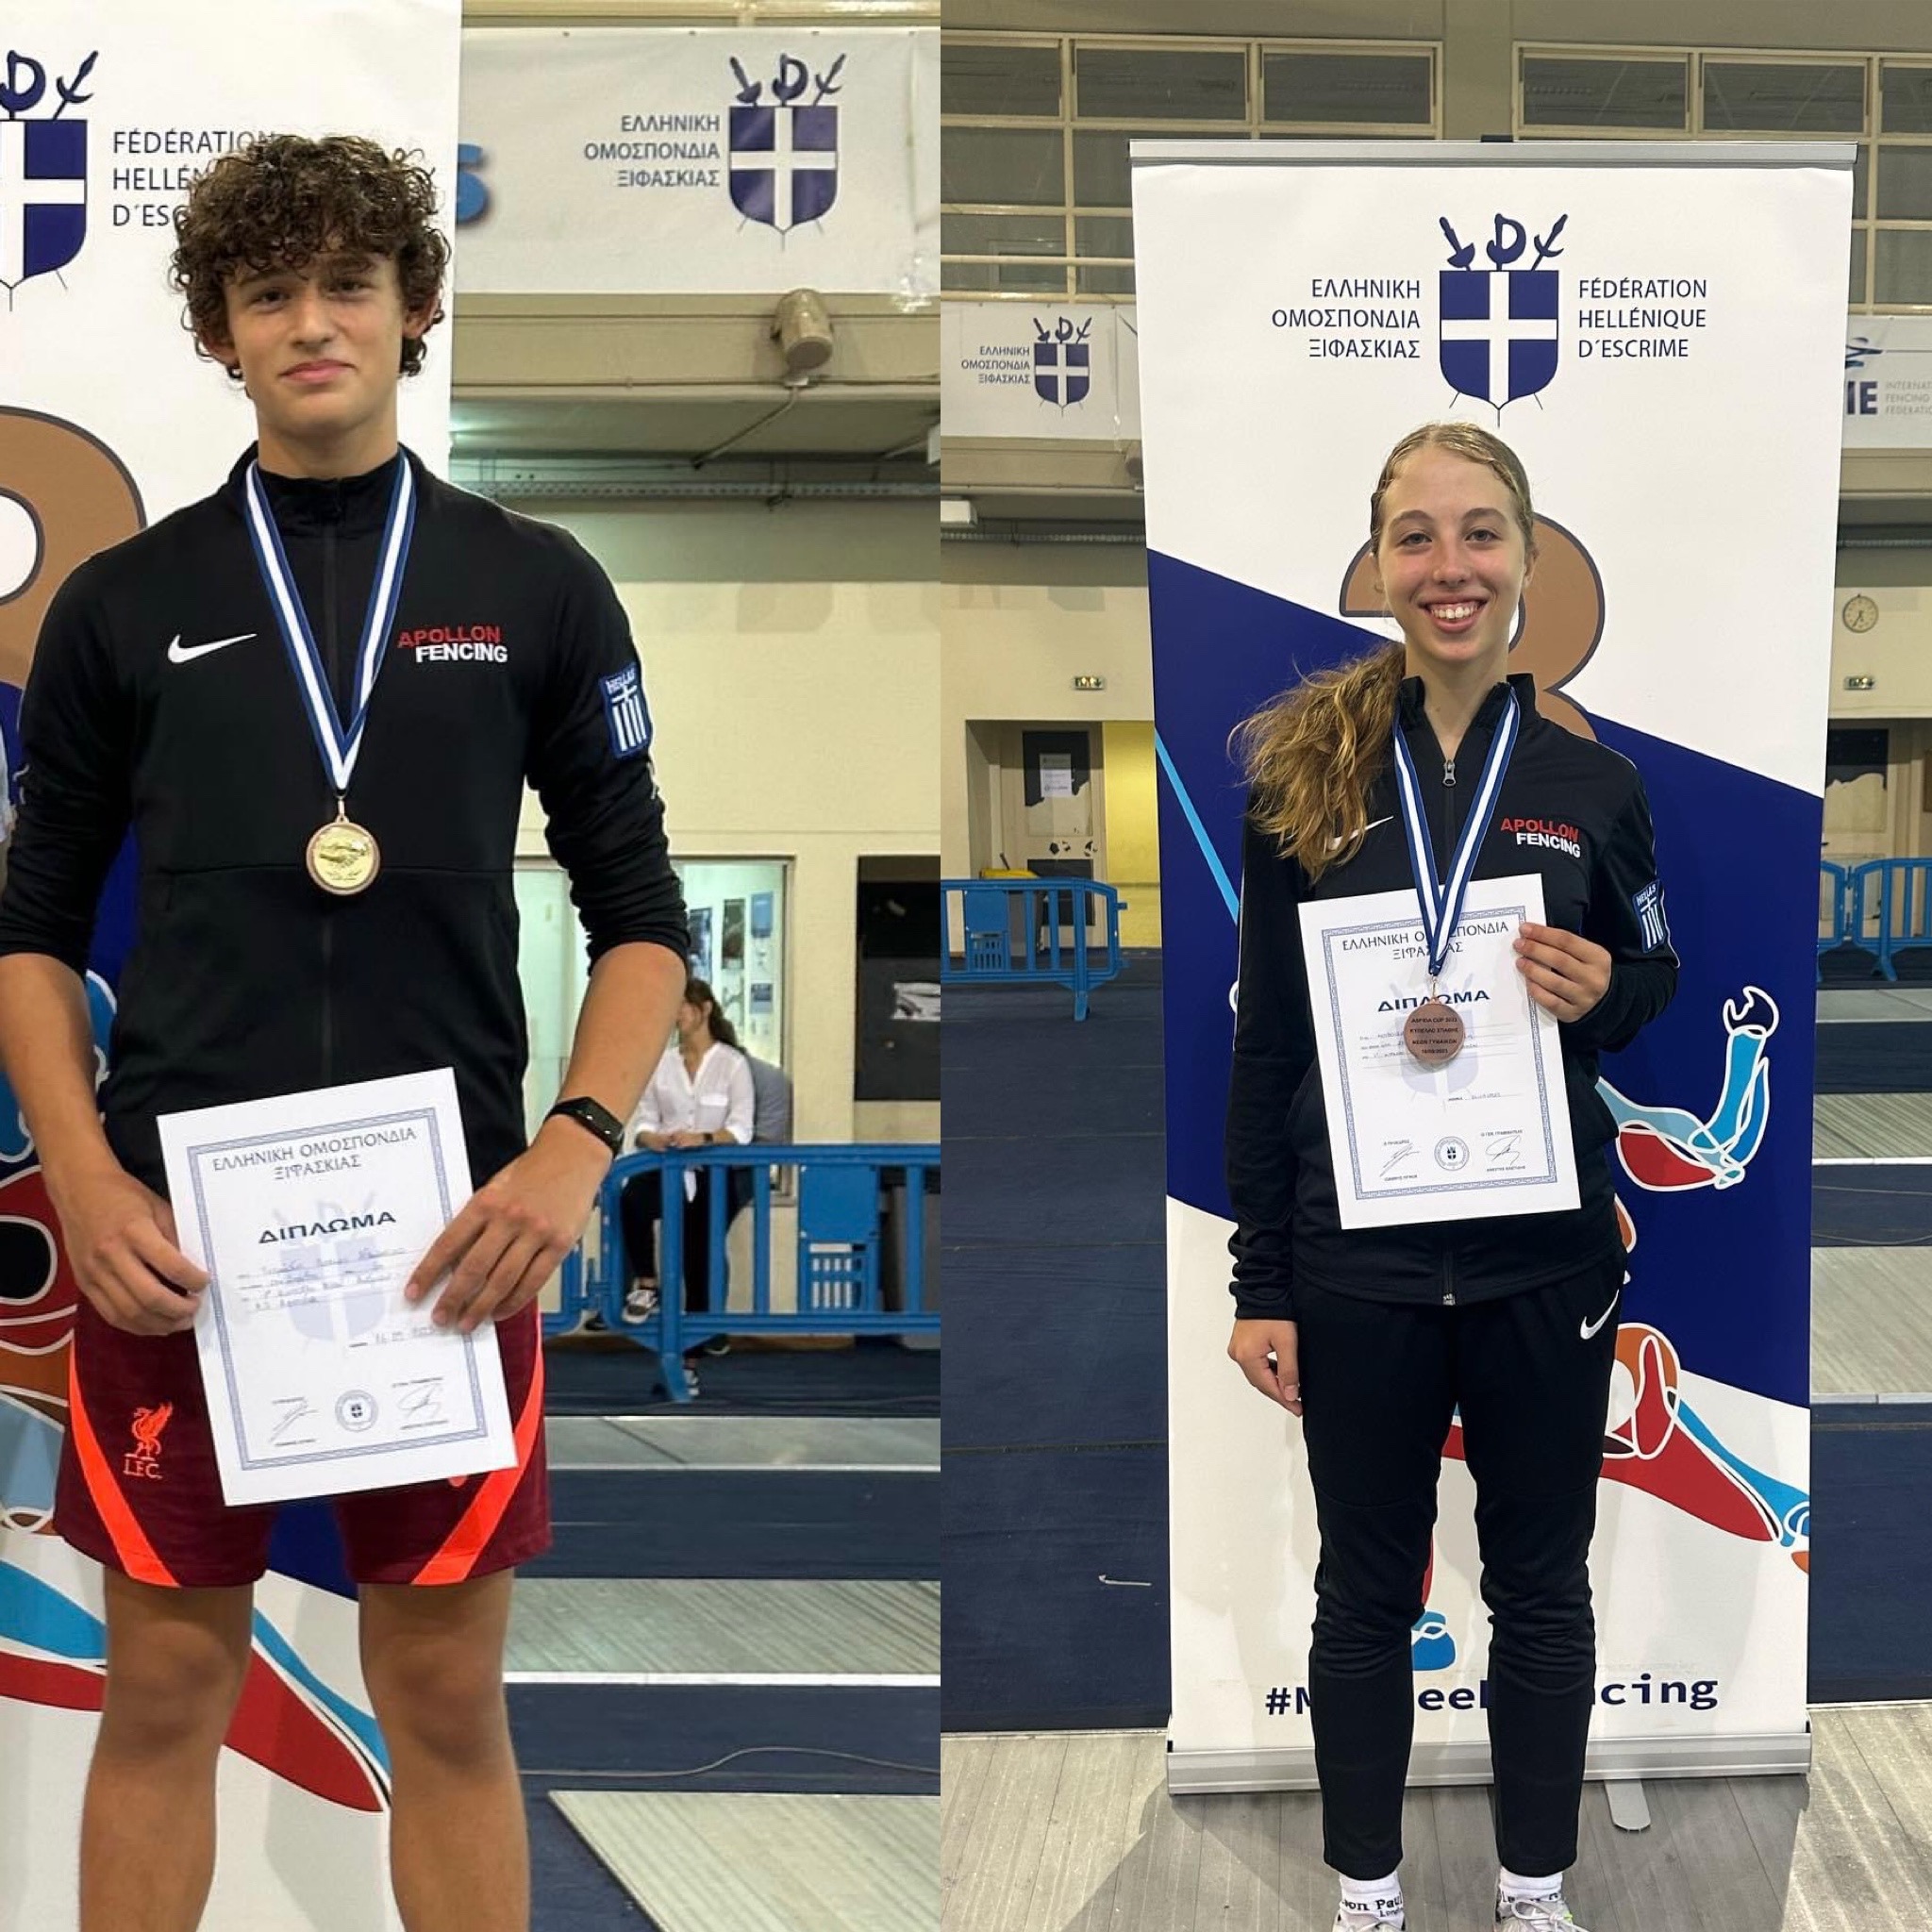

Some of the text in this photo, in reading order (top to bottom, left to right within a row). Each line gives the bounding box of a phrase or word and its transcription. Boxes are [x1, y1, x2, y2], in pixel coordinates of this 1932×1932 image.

[620, 114, 720, 131] ΕΛΛΗΝΙΚΗ
[584, 142, 720, 159] ΟΜΟΣΠΟΝΔΙΑ
[617, 170, 720, 187] ΞΙΦΑΣΚΙΑΣ
[1311, 278, 1420, 299] ΕΛΛΗΝΙΚΗ
[1578, 277, 1707, 298] FÉDÉRATION
[1272, 309, 1420, 328] ΟΜΟΣΠΟΝΔΙΑ
[1578, 307, 1707, 329] HELLÉNIQUE
[979, 345, 1030, 357] ΕΛΛΗΝΙΚΗ
[1308, 339, 1420, 358] ΞΙΦΑΣΚΙΑΣ
[961, 359, 1030, 371] ΟΜΟΣΠΟΝΔΙΑ
[978, 374, 1031, 385] ΞΙΦΑΣΚΙΑΣ
[397, 625, 502, 648] APOLLON
[415, 643, 508, 663] FENCING
[1500, 818, 1580, 842] APOLLON
[1516, 833, 1581, 858] FENCING
[1342, 933, 1409, 951] ΕΛΛΗΝΙΚΗ
[212, 1126, 418, 1172] ΕΛΛΗΝΙΚΗ ΟΜΟΣΠΟΝΔΙΑ
[274, 1154, 361, 1181] ΞΙΦΑΣΚΙΑΣ
[258, 1210, 397, 1244] ΔΙΠΛΩΜΑ
